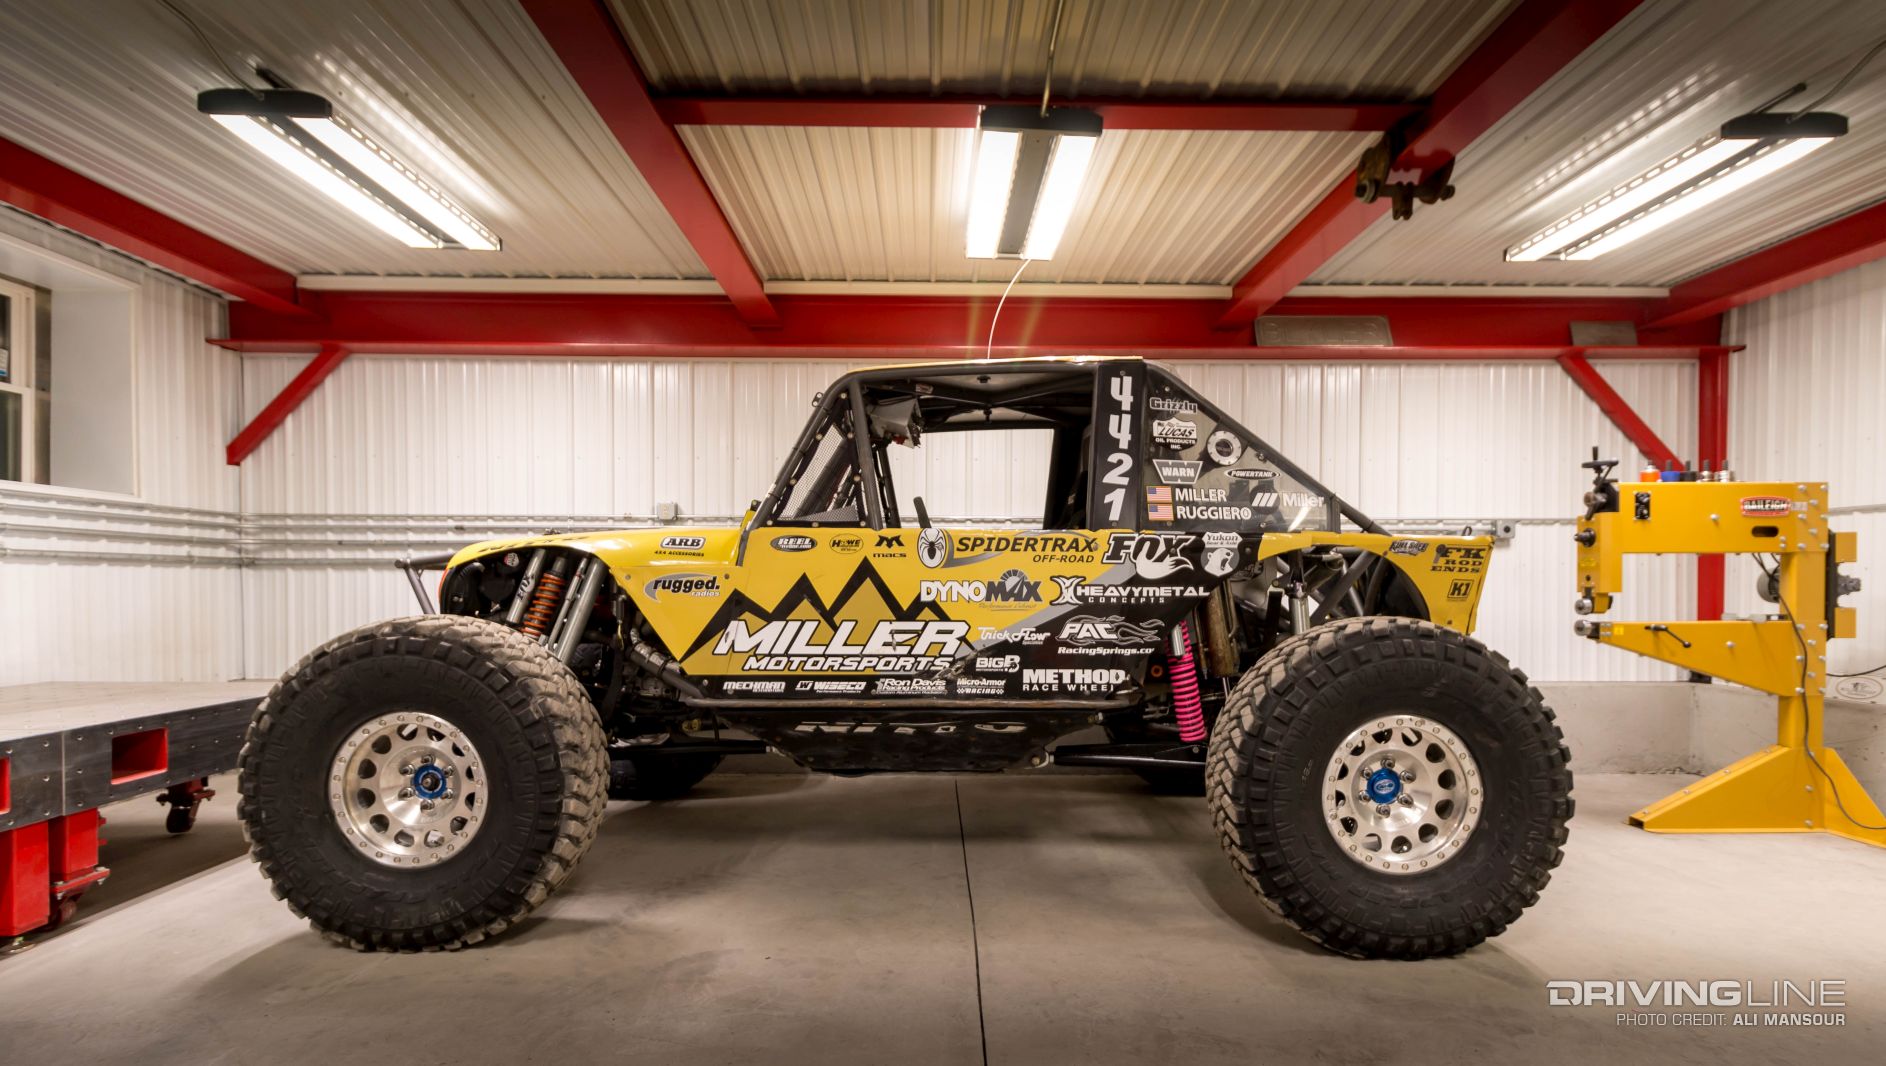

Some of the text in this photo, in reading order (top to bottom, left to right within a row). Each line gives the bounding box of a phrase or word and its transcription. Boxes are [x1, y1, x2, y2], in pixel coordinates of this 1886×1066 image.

[1150, 397, 1198, 414] Grizzly
[1158, 427, 1195, 438] LUCAS
[1102, 375, 1134, 521] 4421
[1162, 467, 1195, 477] WARN
[1231, 470, 1274, 478] POWERTANK
[1175, 488, 1227, 502] MILLER
[1283, 493, 1325, 508] Miller
[1176, 506, 1252, 520] RUGGIERO
[665, 538, 701, 547] ARB
[778, 537, 812, 546] REEL
[956, 536, 1098, 553] SPIDERTRAX
[1101, 532, 1196, 565] FOX
[1440, 547, 1486, 559] FK
[1032, 554, 1095, 563] OFF-ROAD
[1431, 565, 1480, 573] ENDS
[920, 578, 1043, 603] DYNOMAX
[1076, 586, 1211, 597] HEAVYMETAL
[1058, 623, 1119, 639] PAC
[712, 620, 969, 656] MILLER
[743, 656, 951, 671] MOTORSPORTS
[957, 678, 1006, 686] Micro-Armor
[1022, 668, 1126, 684] METHOD
[722, 681, 786, 690] MECHMAN
[965, 687, 996, 695] RACING
[1022, 684, 1059, 692] RACE
